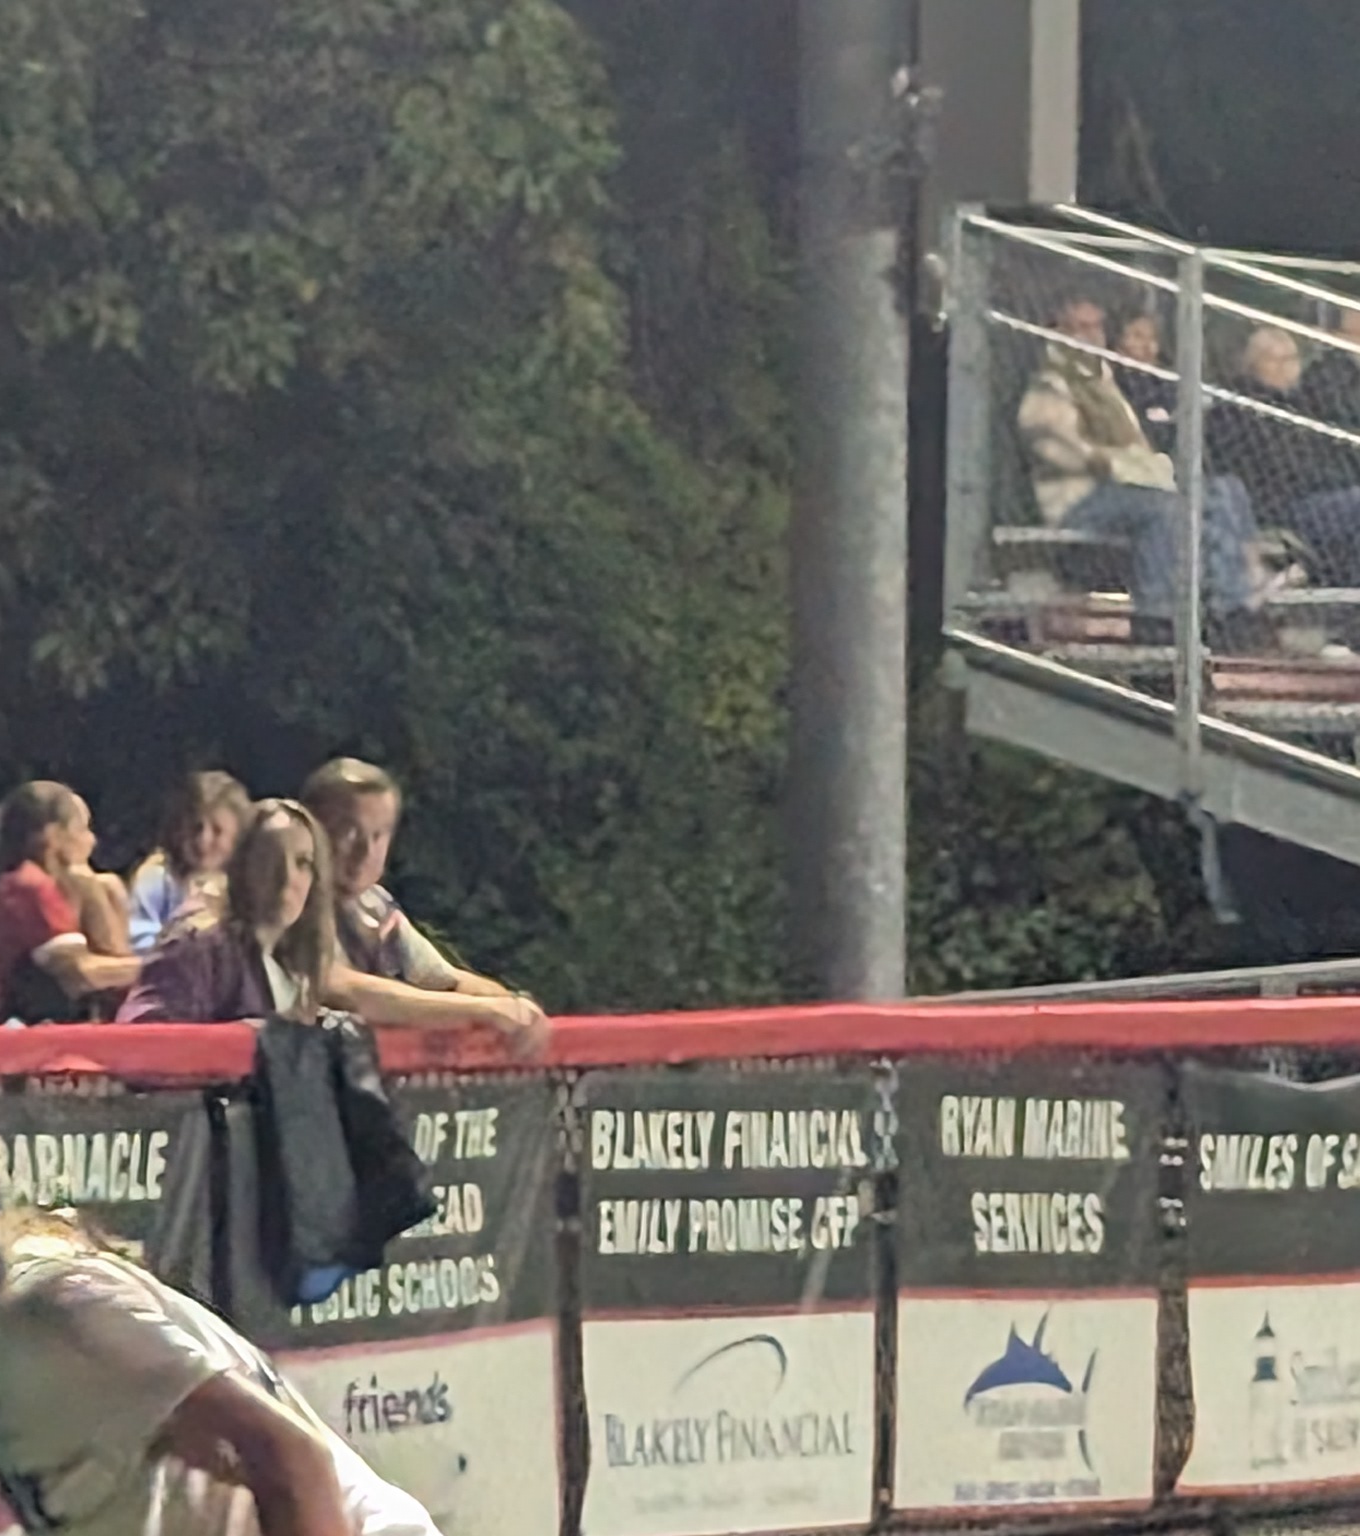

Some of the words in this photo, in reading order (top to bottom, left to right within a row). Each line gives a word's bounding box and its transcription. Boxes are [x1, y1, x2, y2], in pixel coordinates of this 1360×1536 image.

[414, 1112, 448, 1165] OF
[455, 1107, 499, 1160] THE
[591, 1110, 715, 1169] BLAKELY
[724, 1110, 869, 1169] FINANCIAL
[941, 1095, 1016, 1157] RYAN
[1022, 1097, 1129, 1160] MARINE
[1200, 1133, 1298, 1191] SMILES
[1306, 1133, 1340, 1191] OF
[1337, 1132, 1360, 1190] S
[598, 1198, 681, 1254] EMILY
[970, 1192, 1106, 1254] SERVICES
